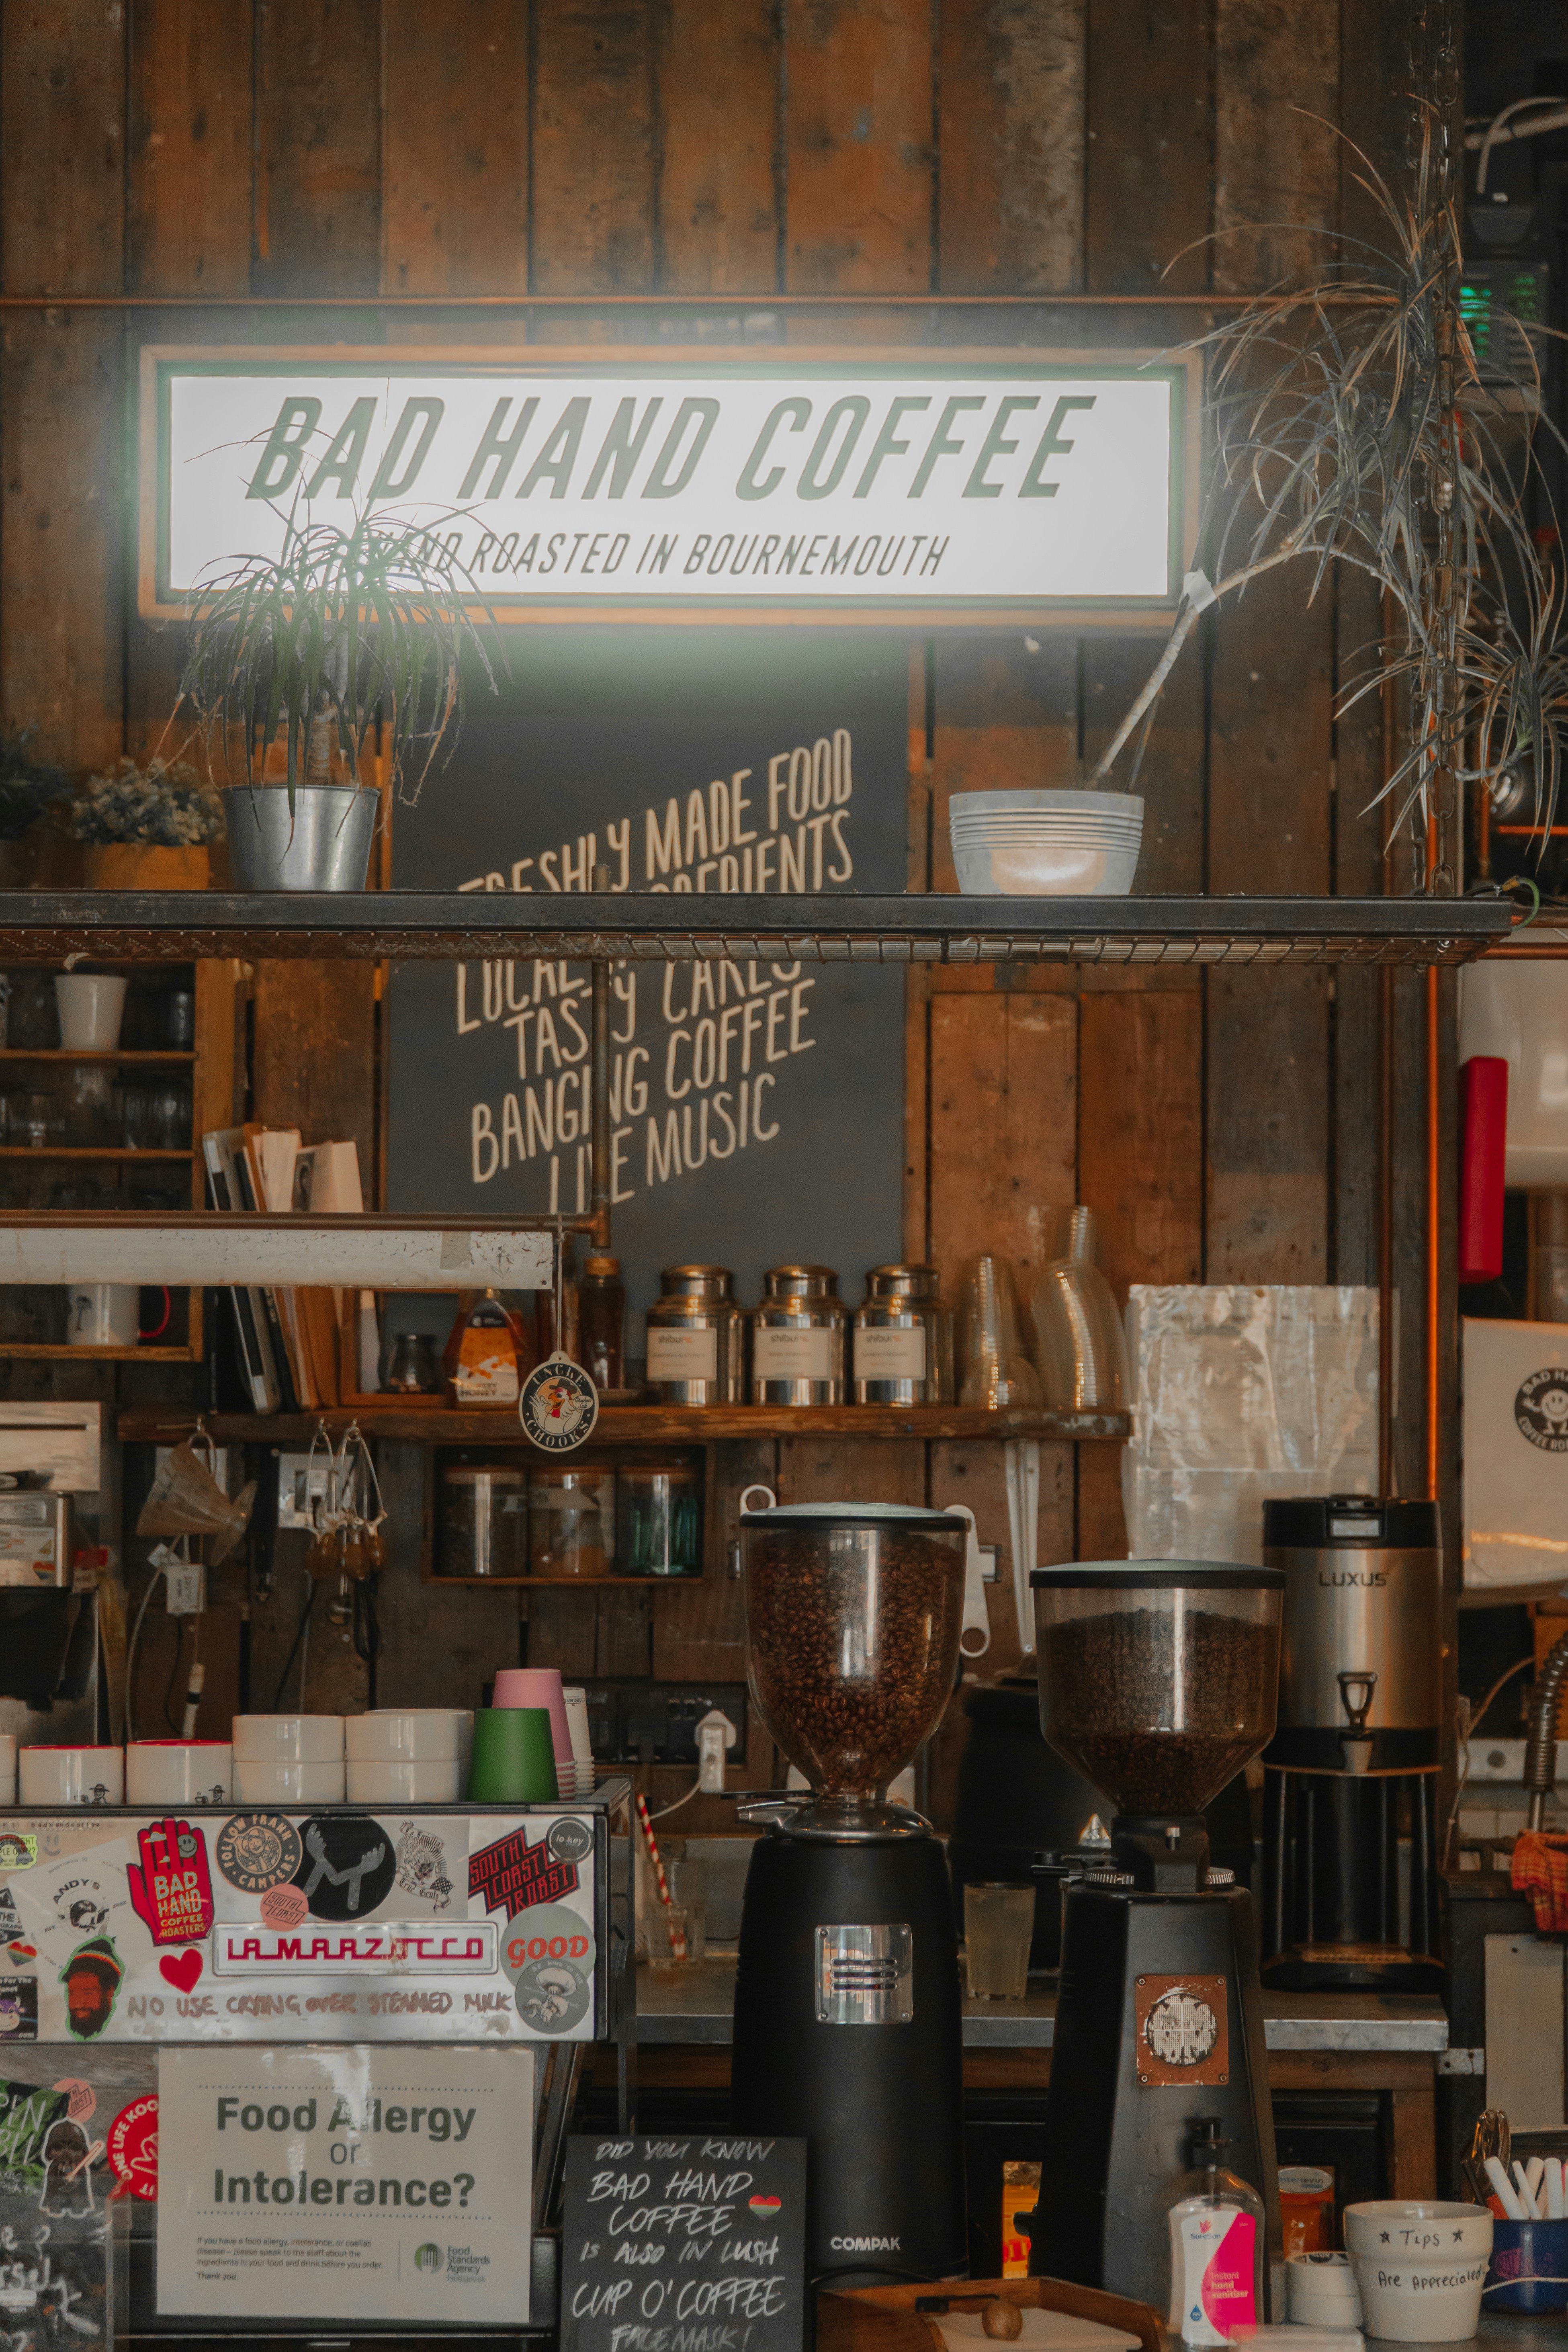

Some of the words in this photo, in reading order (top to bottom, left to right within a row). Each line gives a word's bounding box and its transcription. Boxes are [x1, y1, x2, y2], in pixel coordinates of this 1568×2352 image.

[244, 396, 445, 500] BAD
[456, 396, 720, 500] HAND
[735, 395, 1097, 501] COFFEE
[468, 532, 631, 575] ROASTED
[636, 533, 679, 575] IN
[684, 534, 950, 576] BOURNEMOUTH
[645, 768, 758, 880] MADE
[768, 728, 853, 832] FOOD
[502, 971, 636, 1080] TASY
[663, 978, 817, 1099] COFFEE
[551, 1127, 635, 1214] LIE
[647, 1073, 780, 1186] MUSIC
[532, 1364, 586, 1387] UNCLE
[526, 1419, 589, 1447] CHOOK'S
[1318, 1572, 1387, 1587] LUXUS
[252, 1814, 293, 1842] FRANK
[567, 1836, 584, 1846] key
[221, 1817, 246, 1869] FOLLOW
[238, 1854, 295, 1889] CAMPERS
[470, 1838, 520, 1886] SOUTH
[492, 1852, 540, 1900] COAST
[53, 1878, 100, 1905] ANDY'S
[154, 1871, 198, 1901] BAD
[419, 1888, 439, 1899] Gents
[513, 1864, 569, 1913] ROAST
[158, 1888, 202, 1918] HAND
[268, 1894, 299, 1909] SOUTH
[270, 1905, 300, 1922] COAST
[161, 1914, 204, 1927] COFFEE
[227, 1938, 261, 1961] LA
[277, 1938, 483, 1961] MARZOCCO
[507, 1935, 589, 1969] GOOD
[127, 1996, 165, 2018] NO
[176, 1995, 218, 2018] USE
[226, 1995, 301, 2017] CRYING
[305, 1992, 358, 2014] OVER
[464, 1992, 512, 2012] MILK
[125, 2099, 158, 2124] KOO
[217, 2096, 317, 2132] Food
[327, 2098, 477, 2142] Alergy
[112, 2121, 130, 2149] LIFE
[330, 2142, 362, 2165] or
[595, 2141, 635, 2162] DID
[644, 2140, 690, 2162] YOU
[700, 2138, 776, 2162] KNOW
[112, 2151, 134, 2181] ONE
[214, 2168, 476, 2208] Intolerance?
[587, 2171, 651, 2203] BAD
[665, 2168, 753, 2202] HAND
[609, 2203, 736, 2236] COFFEE
[245, 2237, 262, 2245] food
[448, 2244, 470, 2256] Food
[579, 2241, 600, 2263] IS
[613, 2241, 665, 2265] ALSO
[678, 2239, 714, 2264] IN
[720, 2236, 779, 2266] LUSH
[831, 2235, 901, 2251] COMPAK
[1398, 2229, 1441, 2250] Tips
[447, 2255, 491, 2265] Standards
[447, 2263, 481, 2275] Agency
[196, 2272, 221, 2280] Thank
[1211, 2280, 1235, 2289] hand
[1378, 2270, 1402, 2288] Are
[571, 2278, 633, 2319] CUP
[1211, 2290, 1249, 2299] sanitizer
[611, 2323, 673, 2352] FACE
